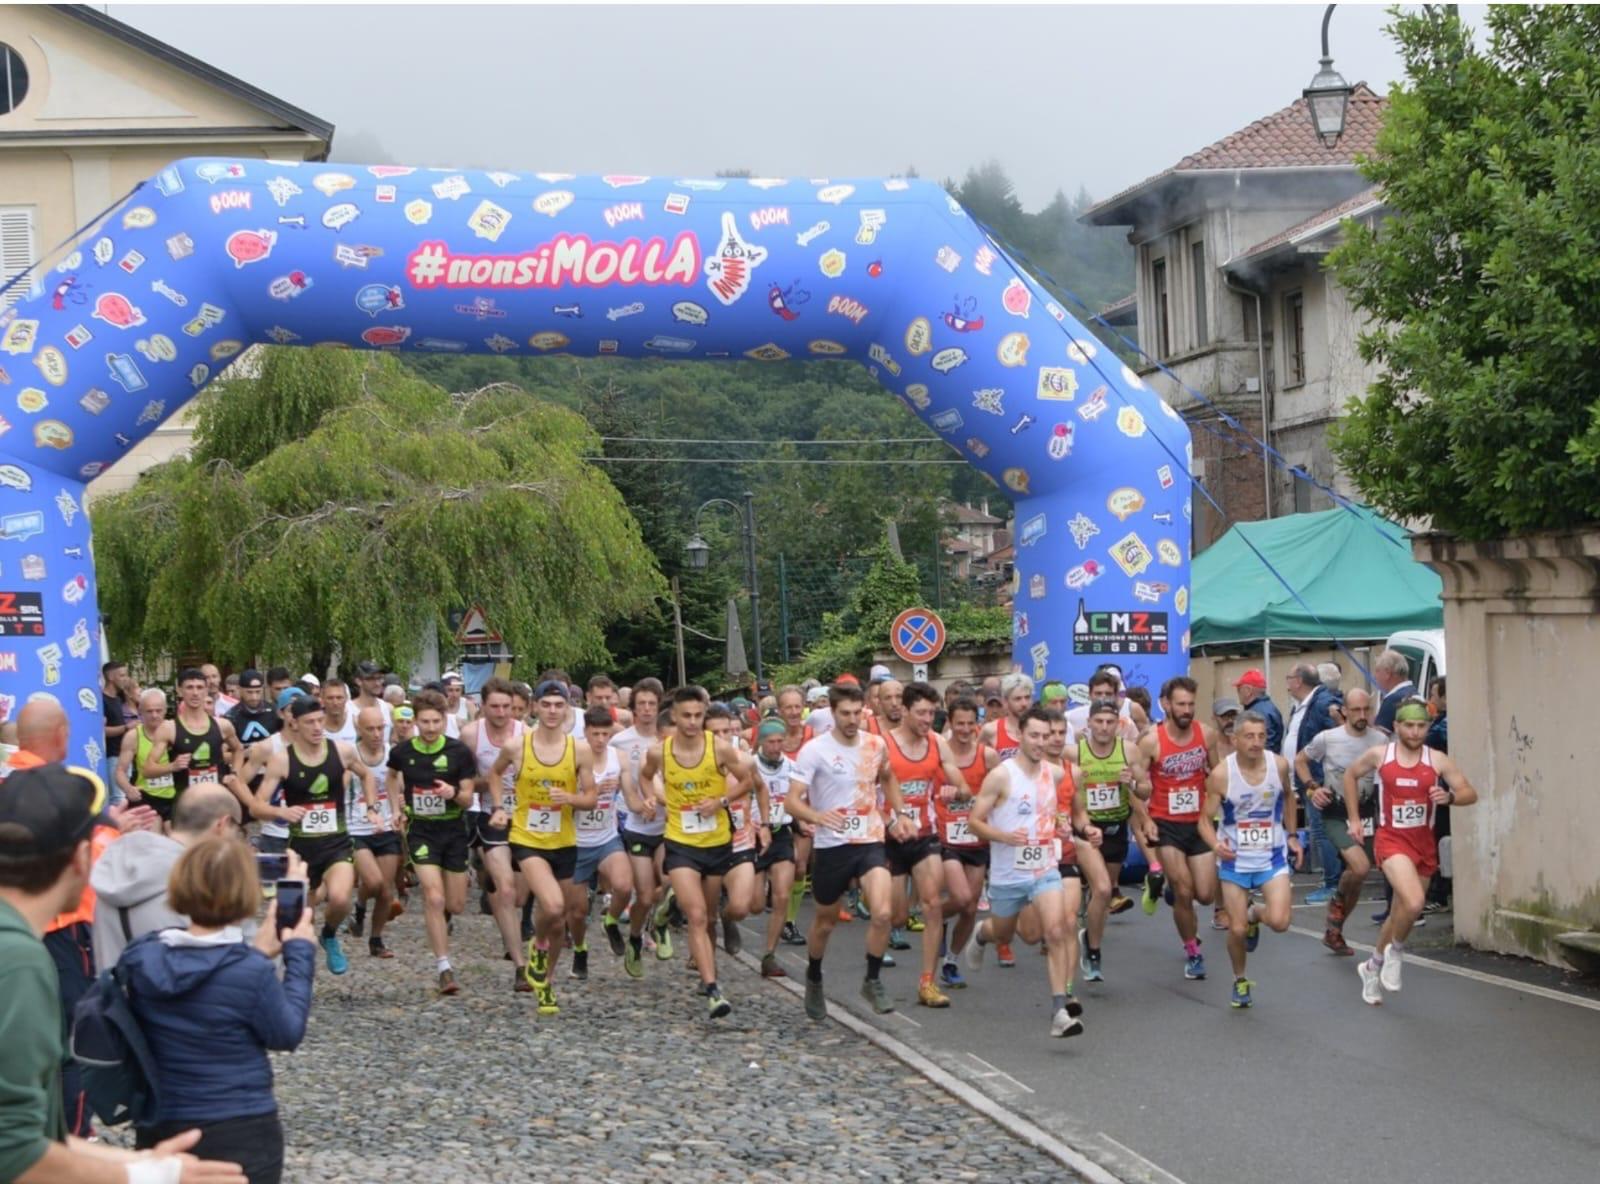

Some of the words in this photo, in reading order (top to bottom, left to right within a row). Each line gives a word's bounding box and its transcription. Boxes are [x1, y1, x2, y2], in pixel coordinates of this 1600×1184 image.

[211, 191, 251, 214] BOOM
[604, 203, 643, 228] BOOM
[750, 208, 788, 231] BOOM
[411, 237, 697, 285] #nonsiMOLLA
[828, 295, 869, 326] BOOM
[415, 795, 443, 808] 102
[1089, 788, 1116, 803] 157
[1175, 792, 1194, 806] 52
[309, 810, 329, 824] 96
[540, 811, 551, 825] 2
[585, 809, 604, 823] 40
[1394, 805, 1425, 820] 129
[1241, 829, 1269, 842] 104
[1022, 846, 1042, 861] 68
